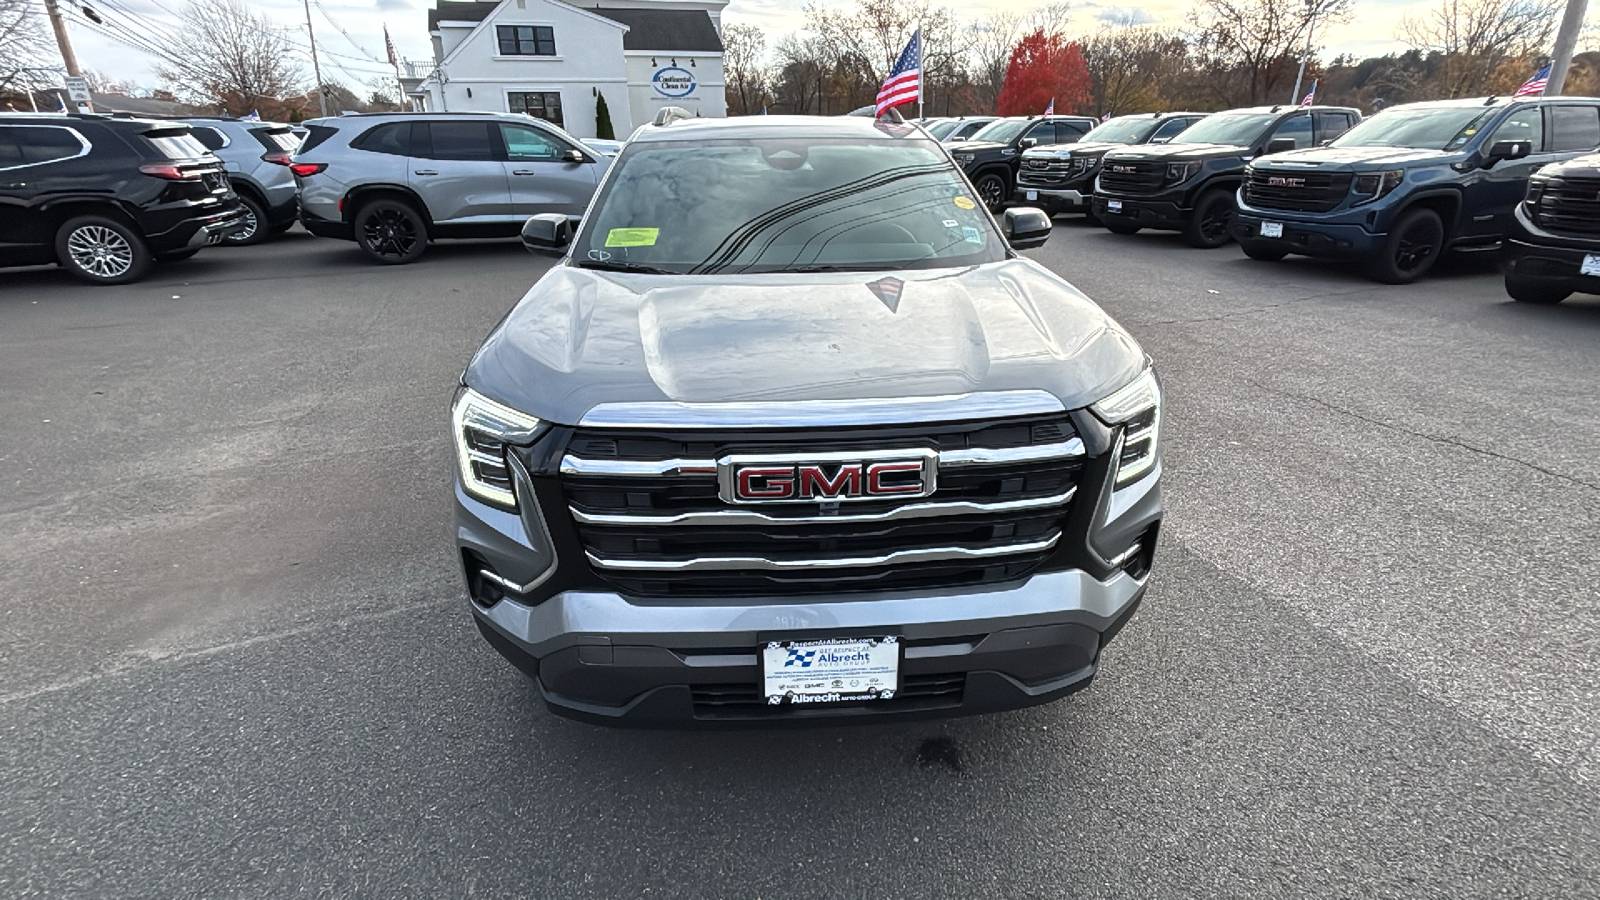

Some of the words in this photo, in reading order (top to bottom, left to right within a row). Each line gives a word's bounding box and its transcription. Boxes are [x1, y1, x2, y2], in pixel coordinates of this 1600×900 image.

[1268, 177, 1305, 187] GMC
[737, 460, 923, 498] GMC
[790, 637, 874, 647] RespectAtAlbrecht.com
[818, 652, 870, 662] Albrecht
[791, 692, 840, 704] Albrecht
